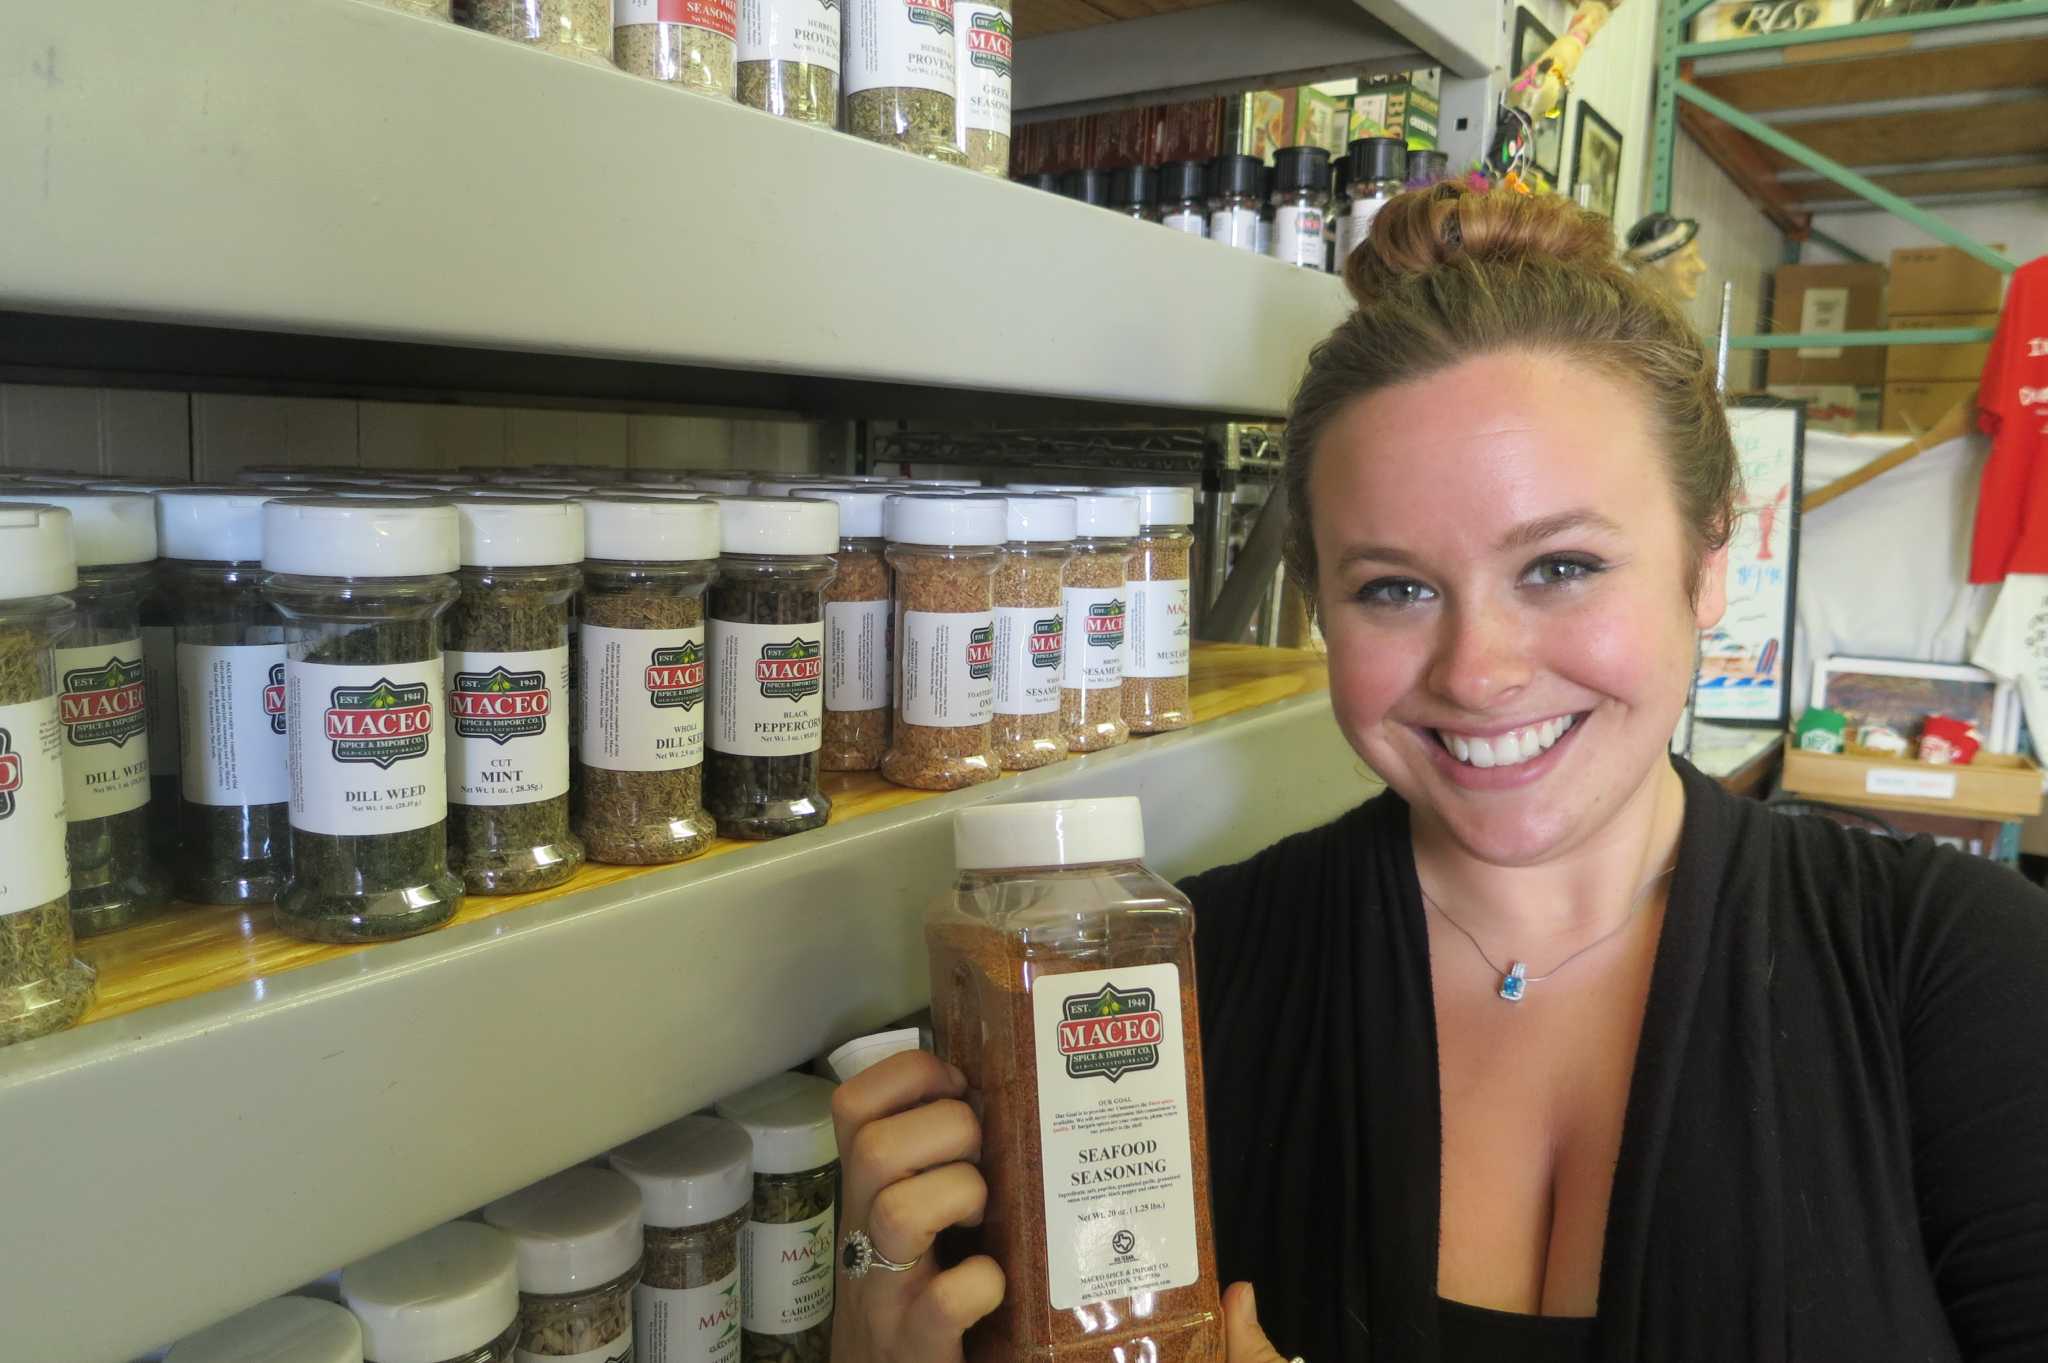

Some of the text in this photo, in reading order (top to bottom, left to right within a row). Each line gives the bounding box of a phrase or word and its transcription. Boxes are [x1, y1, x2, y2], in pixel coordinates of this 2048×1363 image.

[794, 29, 839, 48] PROVEN
[969, 31, 1012, 57] MACE
[649, 667, 704, 687] MACE
[759, 661, 821, 679] MACEO
[461, 679, 538, 688] EST. 1944
[340, 695, 362, 704] EST.
[453, 694, 548, 715] MACEO
[328, 709, 430, 735] MACEO
[493, 718, 526, 726] IMPORT
[783, 711, 808, 719] BLACK
[341, 741, 365, 749] SPICE
[376, 738, 410, 748] IMPORT
[656, 732, 704, 750] DILL SEE
[491, 759, 513, 768] CUT
[656, 752, 668, 760] Net
[86, 761, 146, 785] DILL WEE
[481, 770, 524, 783] MINT
[346, 785, 426, 802] DILL WEED
[1071, 998, 1147, 1014] EST. 1944
[1060, 1017, 1160, 1050] MACEO
[1073, 1053, 1097, 1063] SPICE
[1105, 1048, 1138, 1059] IMPORT
[1113, 1097, 1133, 1105] GOAL
[1078, 1139, 1158, 1165] SEAFOOD
[1071, 1159, 1167, 1187] SEASONING
[1078, 1214, 1092, 1223] Net
